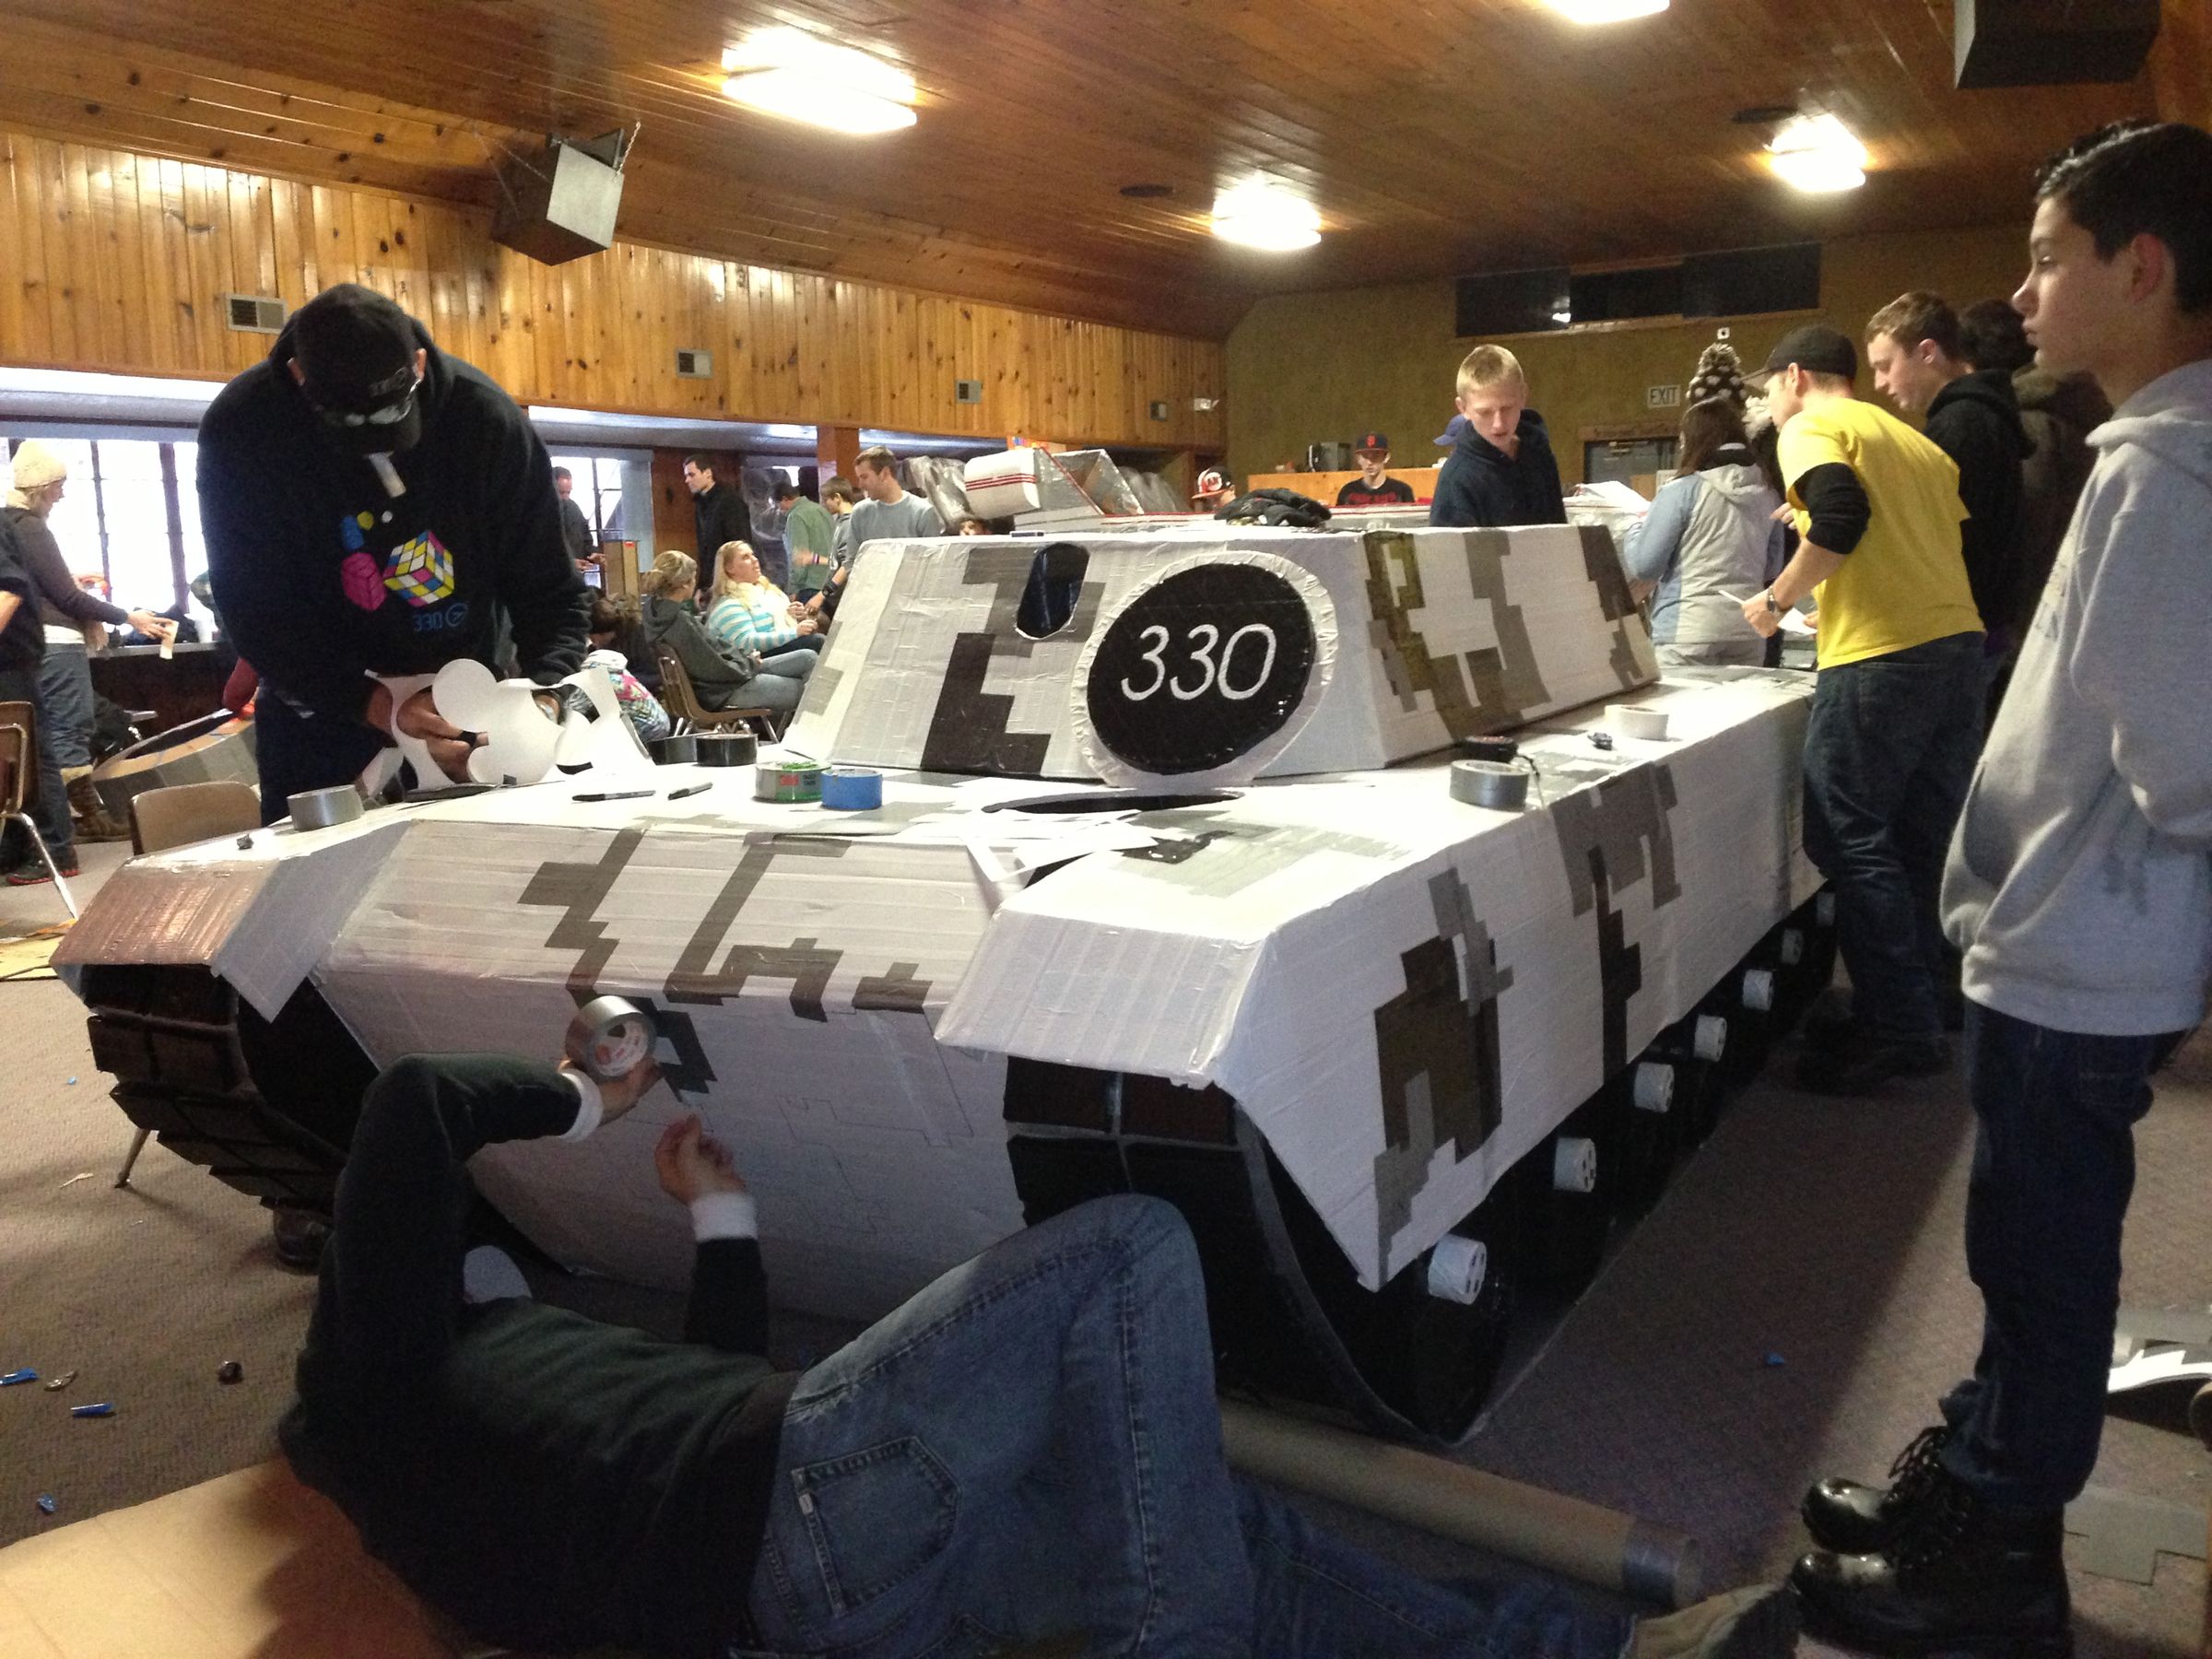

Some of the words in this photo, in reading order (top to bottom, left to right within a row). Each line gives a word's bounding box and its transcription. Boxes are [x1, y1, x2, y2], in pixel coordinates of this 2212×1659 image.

[1650, 387, 1677, 406] EXIT
[412, 611, 442, 632] 330
[1121, 624, 1277, 701] 330
